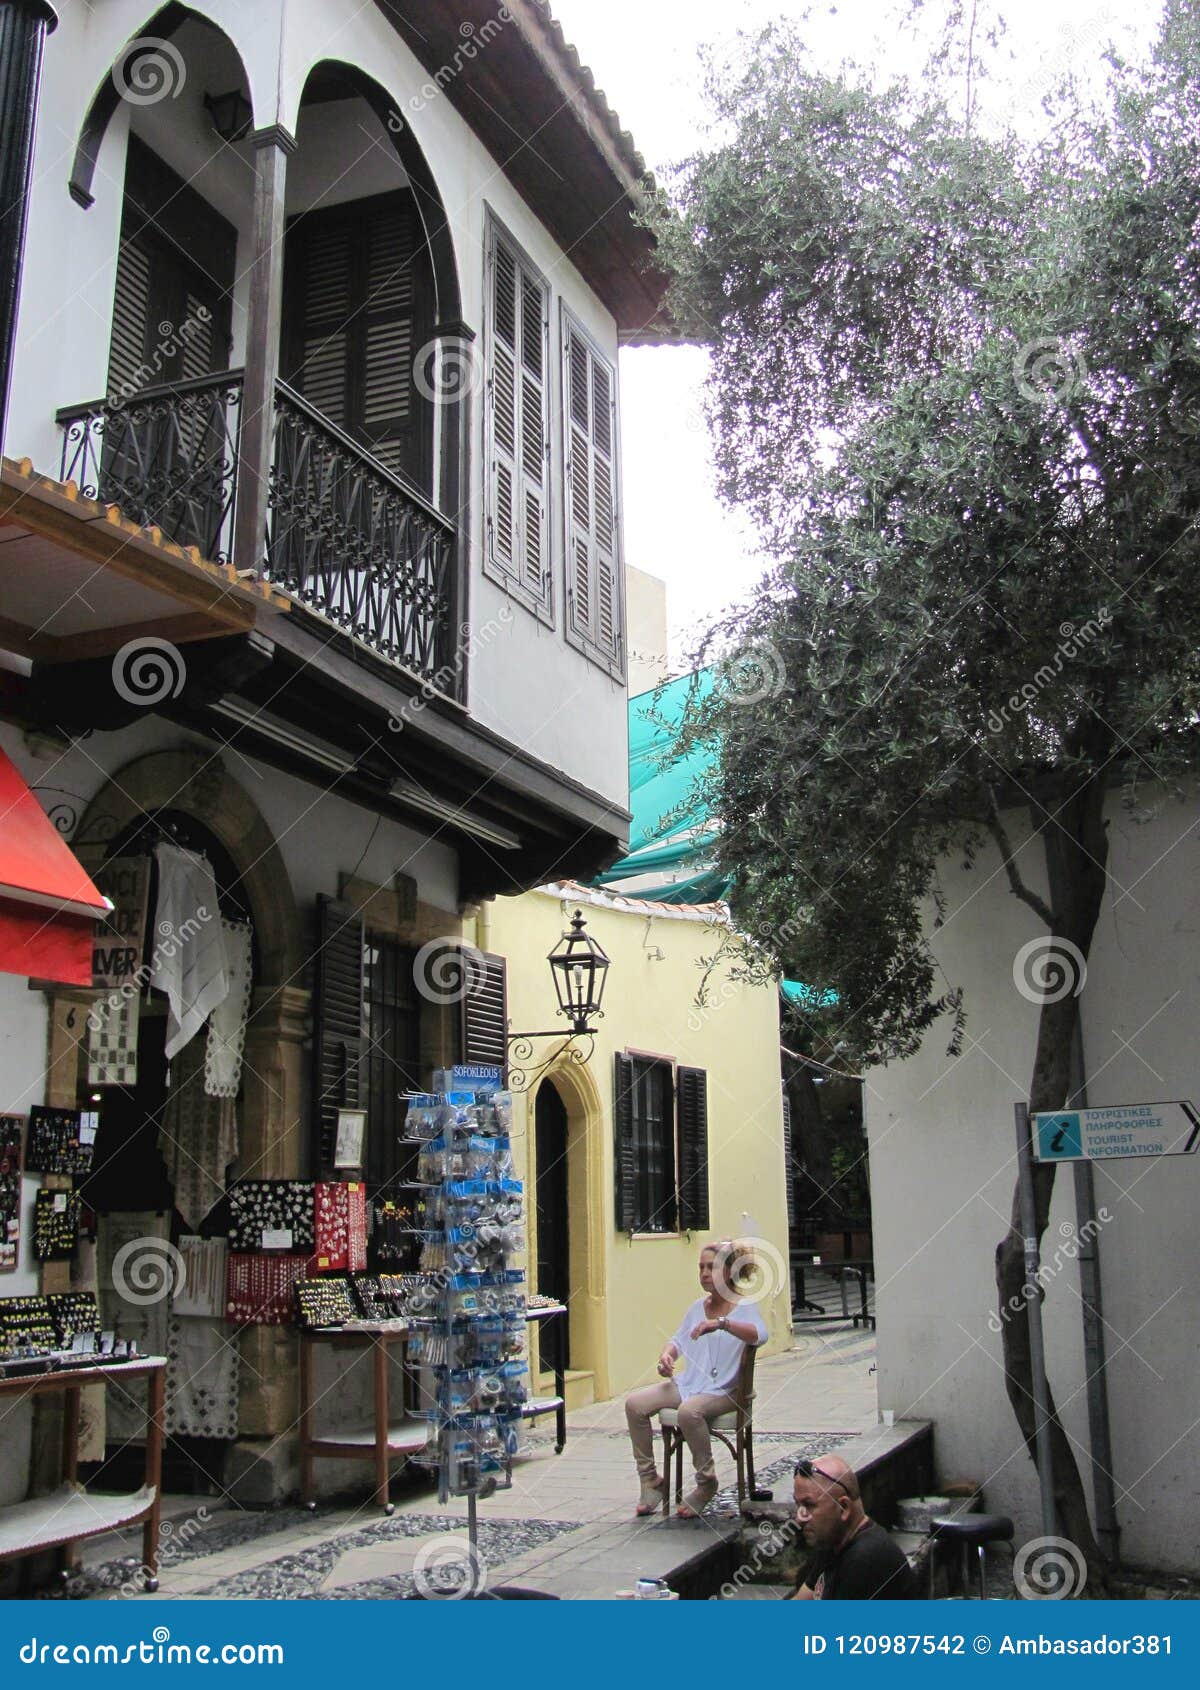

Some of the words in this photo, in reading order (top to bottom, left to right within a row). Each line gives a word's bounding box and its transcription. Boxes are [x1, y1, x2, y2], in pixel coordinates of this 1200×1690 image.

[66, 1007, 77, 1029] 6
[454, 1066, 498, 1079] SOFOKLEOUS
[1087, 1133, 1133, 1146] TOURIST
[1087, 1144, 1164, 1157] INFORMATION
